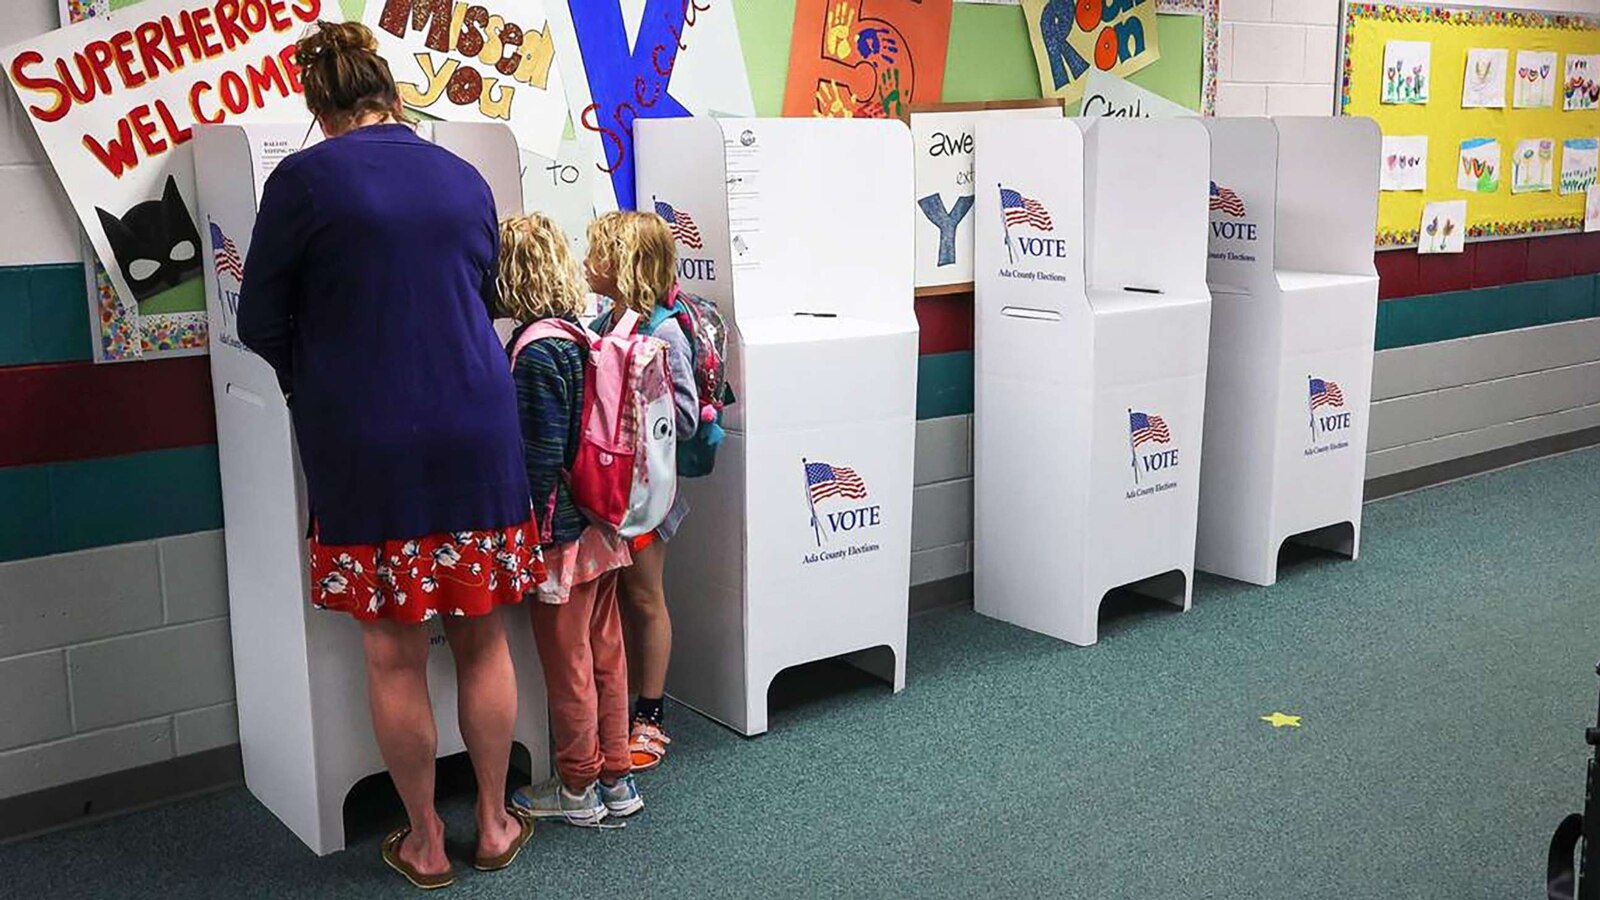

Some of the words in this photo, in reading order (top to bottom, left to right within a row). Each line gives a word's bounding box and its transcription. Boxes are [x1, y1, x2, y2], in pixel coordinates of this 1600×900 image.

[82, 43, 305, 180] WELCOME
[1211, 221, 1257, 241] VOTE
[1017, 236, 1067, 258] VOTE
[1227, 250, 1256, 262] Elections
[674, 257, 716, 280] VOTE
[998, 268, 1011, 278] Ada
[1012, 269, 1035, 281] County
[1036, 271, 1066, 282] Elections
[1319, 412, 1351, 432] VOTE
[1142, 448, 1179, 472] VOTE
[827, 505, 880, 533] VOTE
[802, 552, 819, 565] Ada
[819, 548, 847, 561] County
[848, 542, 880, 556] Elections
